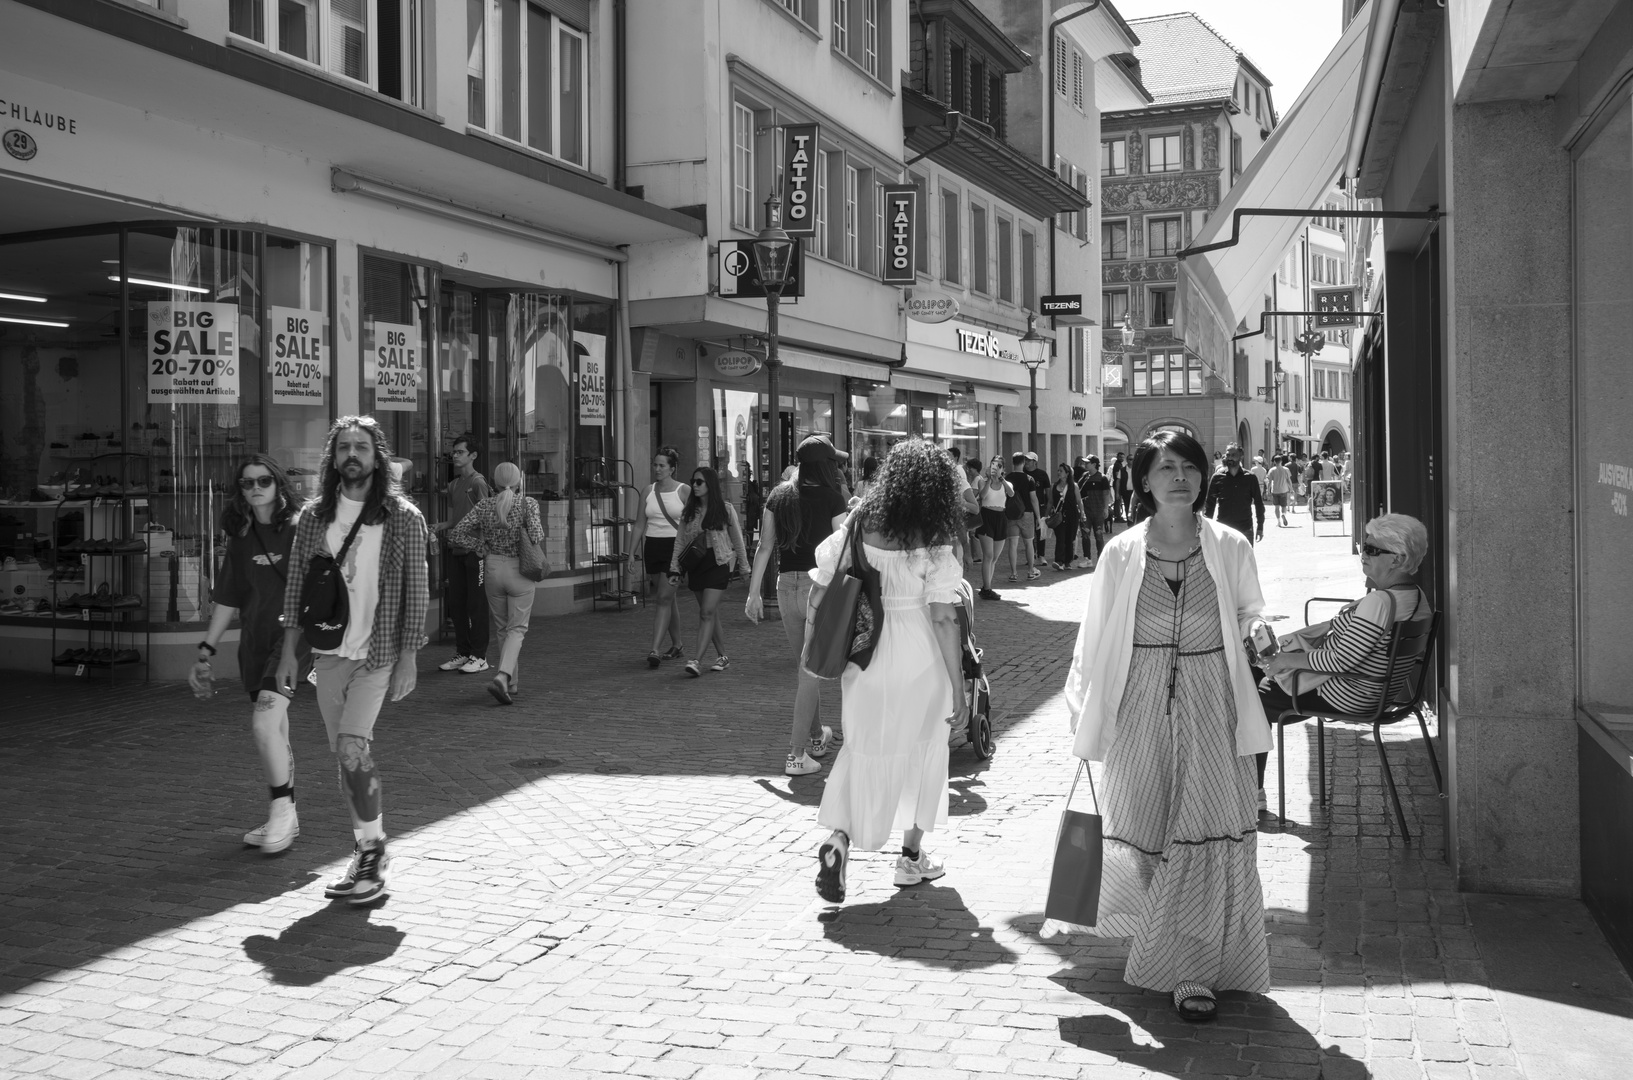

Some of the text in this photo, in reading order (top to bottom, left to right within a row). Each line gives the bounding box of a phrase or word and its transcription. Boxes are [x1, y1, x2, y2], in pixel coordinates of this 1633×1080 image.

[13, 133, 27, 149] 29
[790, 135, 810, 219] TATTOO
[893, 200, 909, 269] TATTOO
[909, 300, 952, 310] LOLIPOP
[174, 311, 214, 328] BIG
[287, 317, 309, 335] BIG
[153, 329, 233, 356] SALE
[275, 333, 320, 361] SALE
[387, 331, 405, 346] BIG
[378, 346, 415, 370] SALE
[718, 357, 752, 365] LOLIPOP
[152, 358, 235, 376] 20-70%
[275, 361, 321, 380] 20-70%
[587, 362, 599, 374] BIG
[173, 378, 199, 386] Rabatt
[377, 371, 416, 387] 20-70%
[581, 374, 604, 393] SALE
[151, 387, 205, 397] ausgewählten
[581, 393, 606, 406] 20-70%
